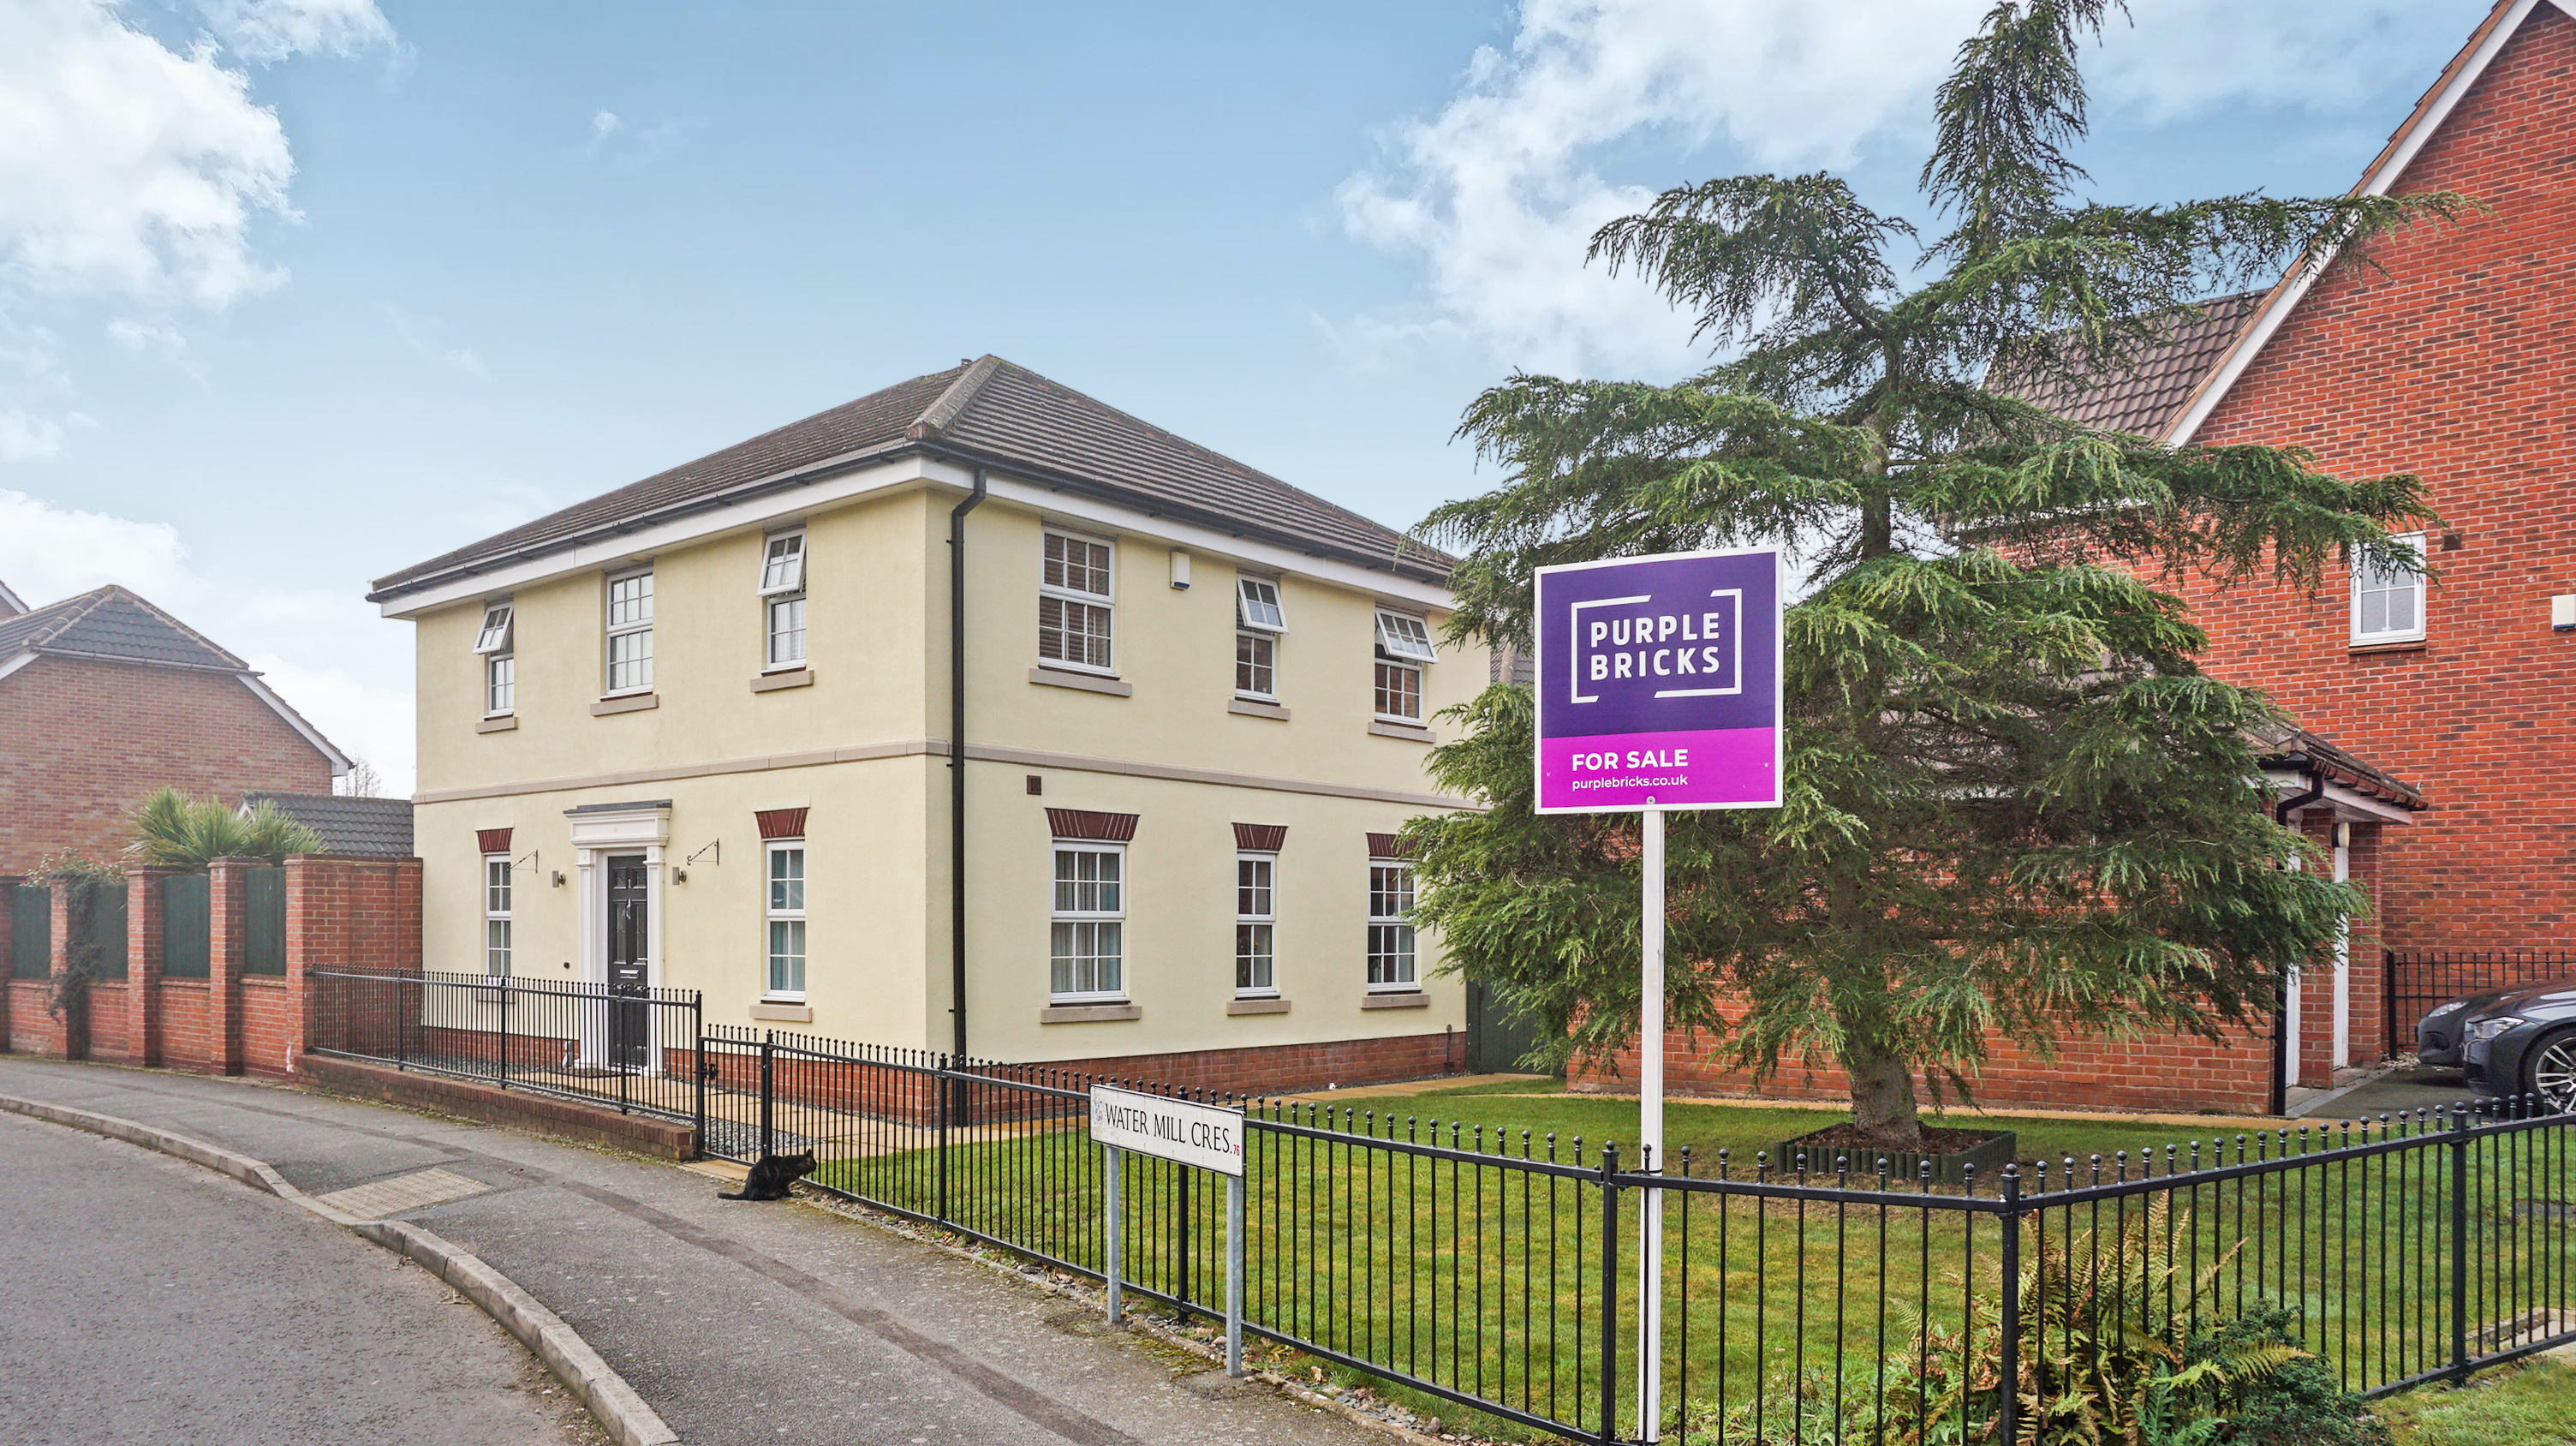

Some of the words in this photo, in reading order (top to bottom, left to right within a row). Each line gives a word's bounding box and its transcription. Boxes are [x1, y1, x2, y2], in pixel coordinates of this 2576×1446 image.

[1590, 612, 1720, 648] PURPLE
[1590, 646, 1720, 681] BRICKS
[1571, 751, 1619, 772] FOR
[1626, 749, 1689, 769] SALE
[1571, 774, 1688, 792] purplebricks.co.uk
[1106, 1102, 1149, 1135] WATER
[1154, 1114, 1186, 1144] MILL
[1191, 1121, 1232, 1154] CRES.
[1233, 1144, 1240, 1156] 76
